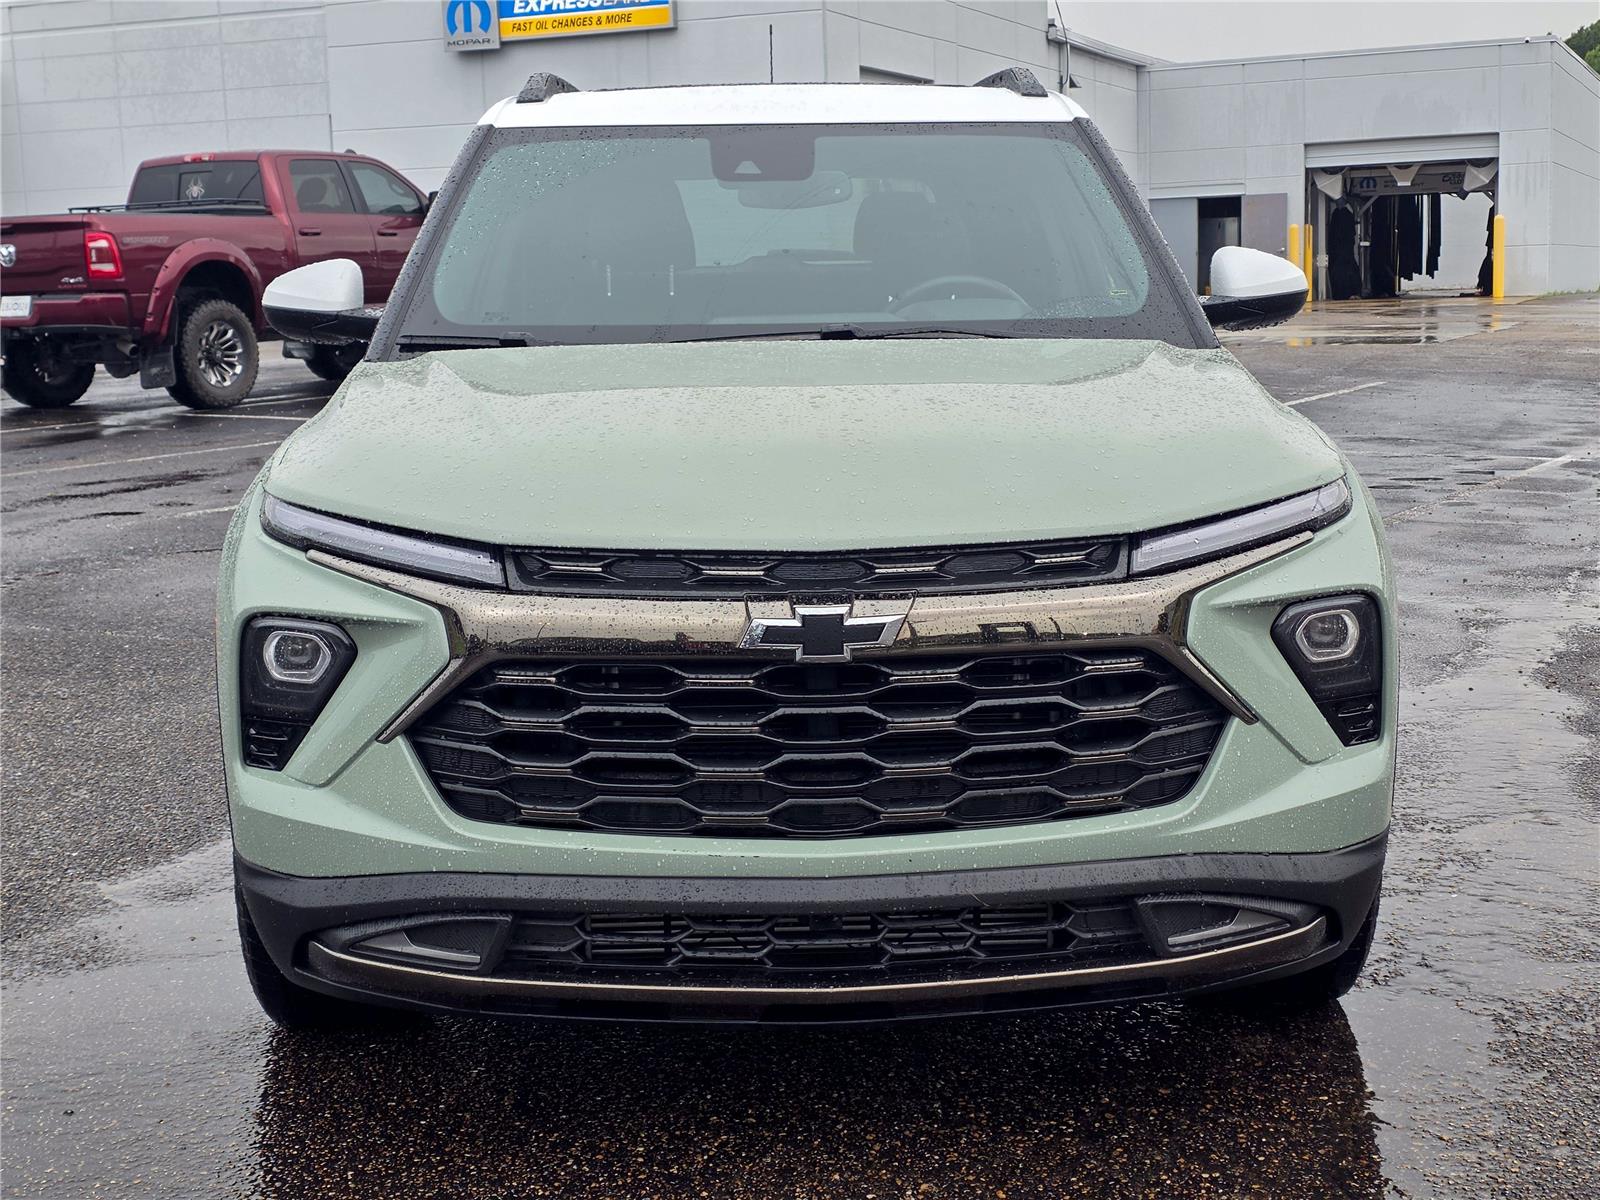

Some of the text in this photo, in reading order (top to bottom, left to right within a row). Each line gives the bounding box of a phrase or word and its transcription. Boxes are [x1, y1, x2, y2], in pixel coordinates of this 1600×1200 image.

[511, 13, 633, 33] FAST OIL CHANGES & MORE
[447, 38, 491, 47] MOPAR
